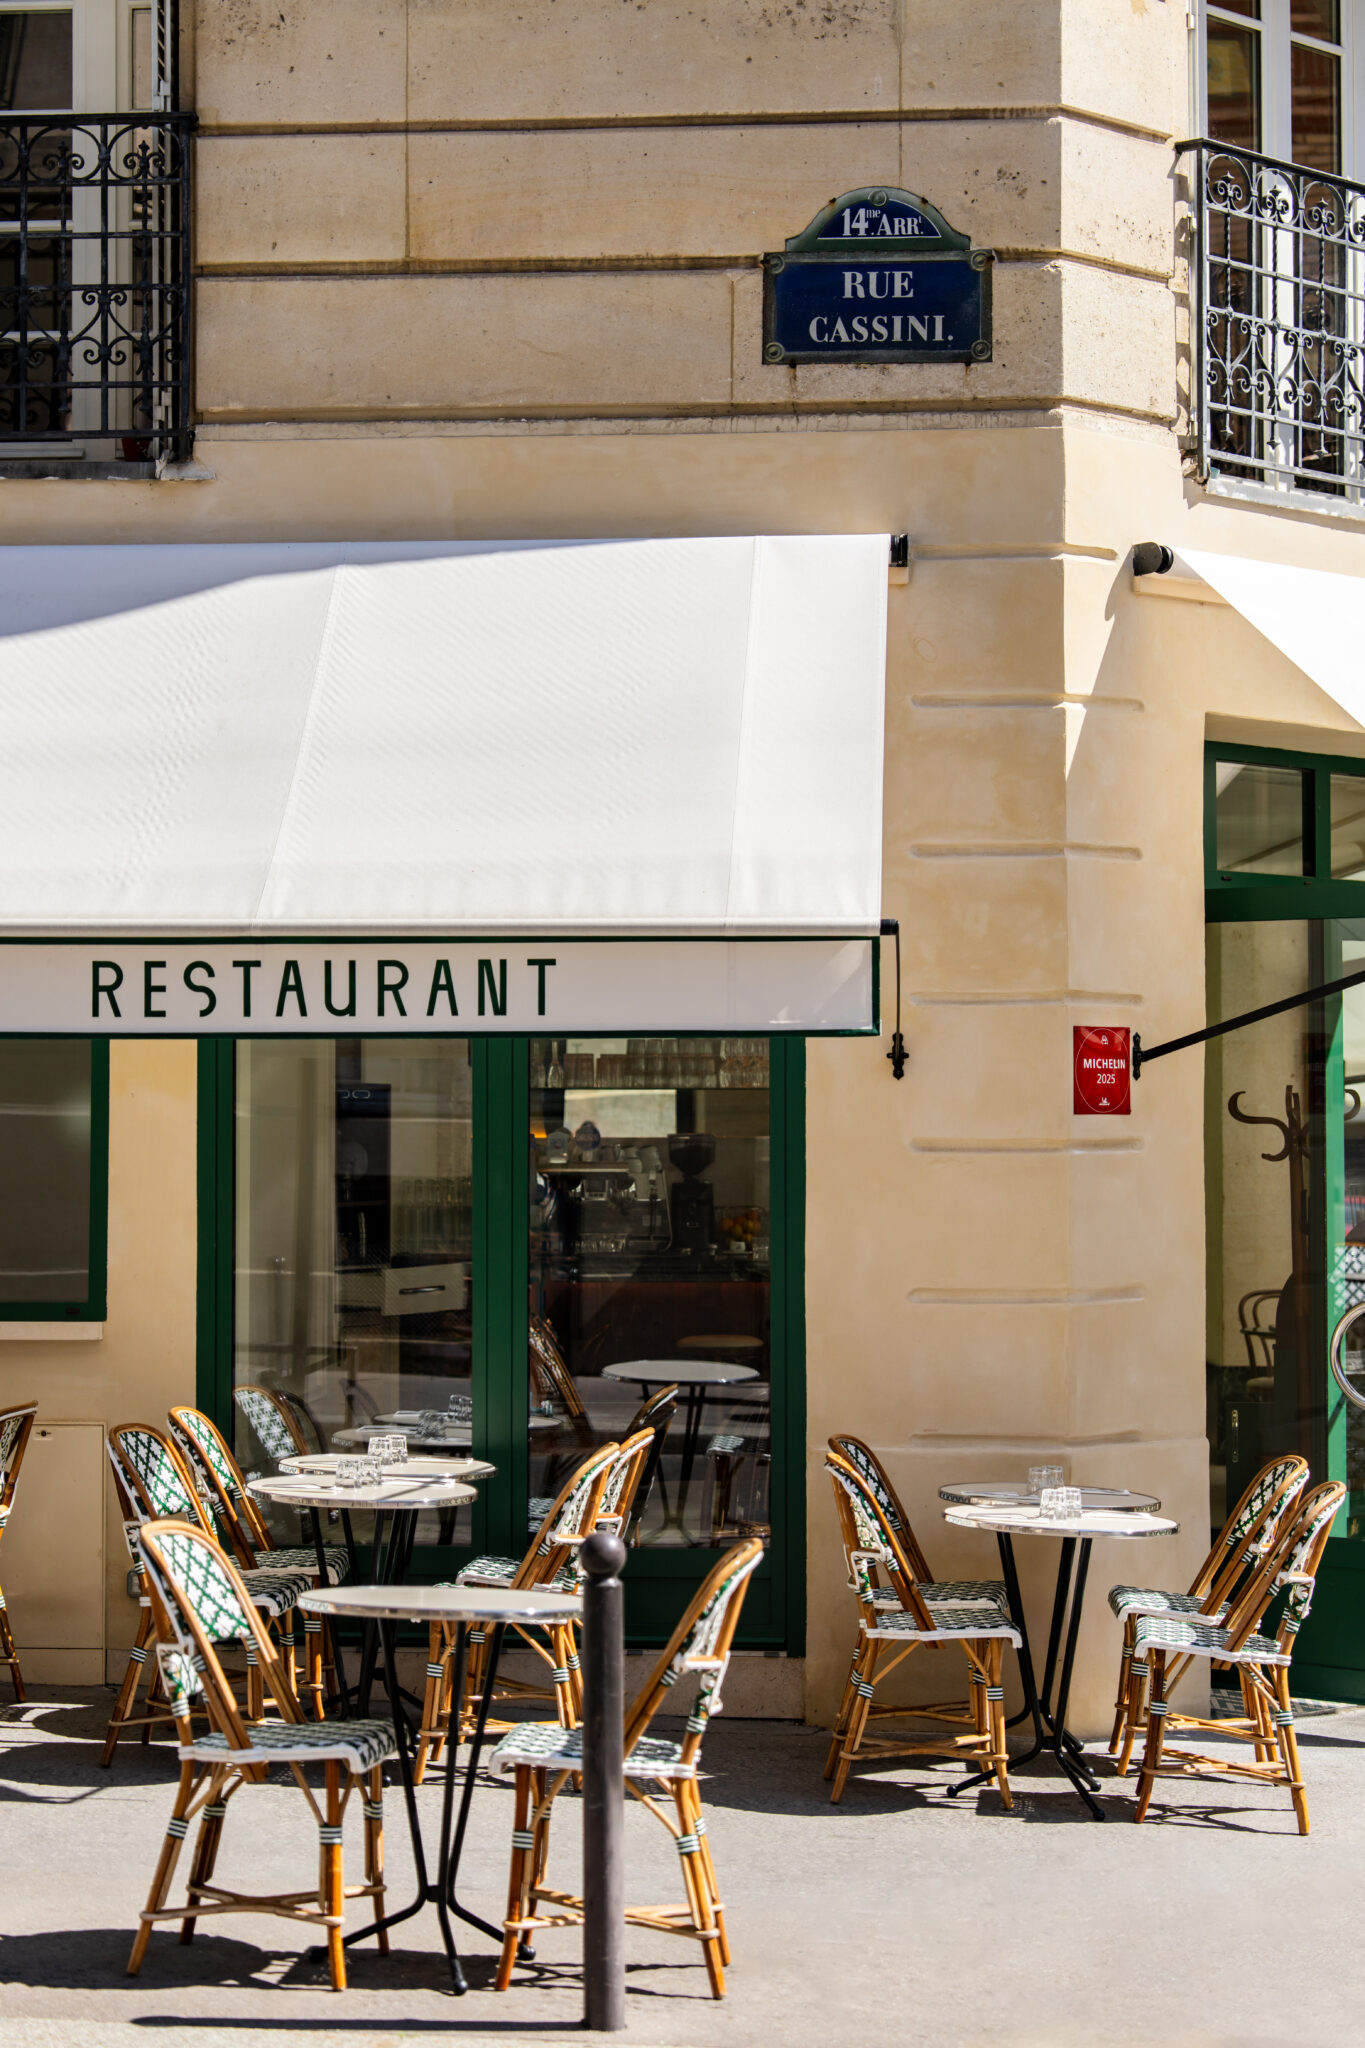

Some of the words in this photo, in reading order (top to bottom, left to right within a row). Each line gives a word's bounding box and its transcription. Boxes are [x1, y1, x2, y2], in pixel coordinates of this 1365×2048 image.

[842, 270, 914, 299] RUE
[808, 315, 954, 343] CASSINI.
[91, 958, 557, 1018] RESTAURANT
[1083, 1058, 1126, 1070] MICHELIN
[1096, 1073, 1116, 1084] 2025
